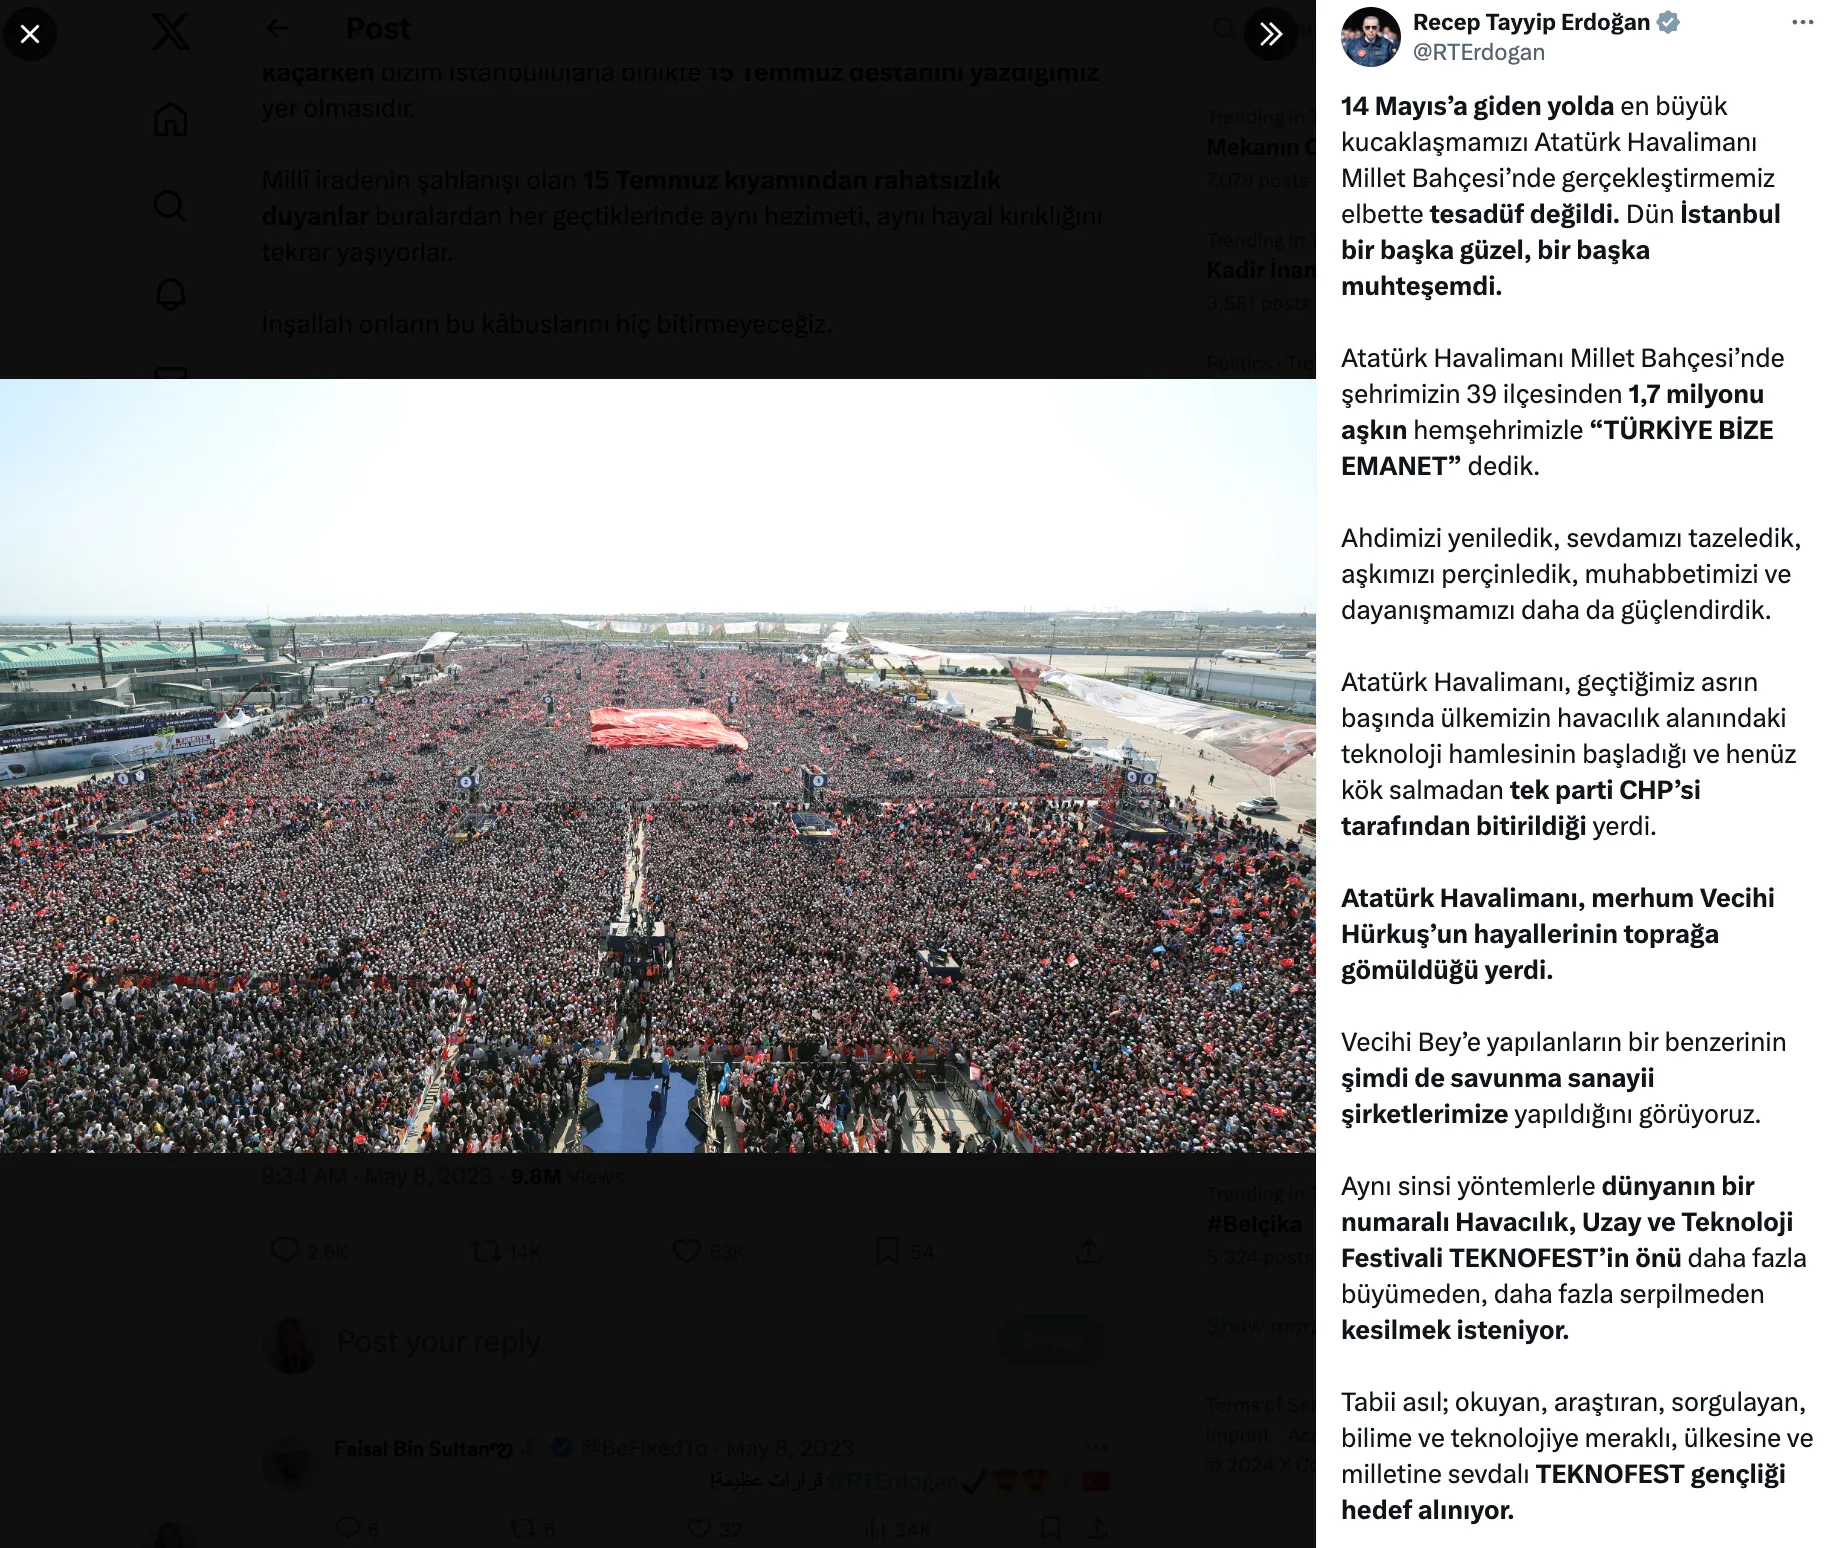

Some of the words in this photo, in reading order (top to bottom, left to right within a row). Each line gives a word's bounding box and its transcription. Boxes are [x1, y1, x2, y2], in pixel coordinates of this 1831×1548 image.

[347, 17, 411, 40] Post
[1415, 14, 1480, 34] Recep
[1486, 13, 1555, 35] Tayyip
[1563, 13, 1649, 35] Erdoğan
[1414, 43, 1544, 64] @RTErdogan
[262, 103, 297, 122] yer
[304, 97, 414, 117] olmasıdır.
[1342, 97, 1369, 115] 14
[1377, 95, 1467, 120] Mayıs’a
[1474, 95, 1540, 120] giden
[1548, 95, 1613, 120] yolda
[1621, 101, 1648, 115] en
[1657, 95, 1727, 120] büyük
[1343, 131, 1527, 156] kucaklaşmamızı
[1535, 131, 1621, 151] Atatürk
[1629, 131, 1755, 151] Havalimanı
[264, 170, 310, 189] Millî
[317, 169, 409, 190] iradenin
[418, 169, 518, 194] şahlanışı
[527, 169, 576, 190] olan
[584, 171, 609, 189] 15
[616, 171, 718, 189] Temmuz
[726, 169, 867, 194] kıyamından
[875, 169, 1001, 190] rahatsızlık
[1343, 167, 1405, 187] Millet
[1414, 167, 1555, 192] Bahçesi’nde
[1562, 167, 1774, 192] gerçekleştirmemiz
[263, 204, 370, 230] duyanlar
[377, 206, 501, 227] buralardan
[510, 206, 547, 225] her
[553, 205, 704, 230] geçtiklerinde
[711, 211, 756, 230] aynı
[766, 205, 870, 228] hezimeti,
[878, 211, 923, 230] aynı
[933, 206, 992, 230] hayal
[1001, 205, 1101, 230] kırıklığını
[1342, 203, 1423, 223] elbette
[1430, 203, 1524, 223] tesadüf
[1531, 203, 1619, 228] değildi.
[1628, 204, 1673, 223] Dün
[1682, 200, 1779, 223] İstanbul
[262, 242, 331, 263] tekrar
[337, 242, 452, 266] yaşıyorlar.
[1343, 239, 1374, 259] bir
[1382, 239, 1453, 264] başka
[1460, 239, 1530, 264] güzel,
[1539, 239, 1570, 259] bir
[1578, 239, 1649, 264] başka
[1343, 275, 1501, 300] muhteşemdi.
[264, 310, 352, 338] İnşallah
[360, 314, 438, 333] onların
[447, 313, 474, 334] bu
[483, 313, 608, 334] kâbuslarını
[617, 314, 650, 338] hiç
[658, 314, 832, 338] bitirmeyeceğiz.
[1341, 347, 1427, 367] Atatürk
[1436, 347, 1562, 367] Havalimanı
[1572, 347, 1634, 367] Millet
[1643, 347, 1784, 372] Bahçesi’nde
[1342, 383, 1459, 408] şehrimizin
[1468, 384, 1496, 403] 39
[1504, 383, 1621, 408] ilçesinden
[1629, 385, 1660, 407] 1,7
[1668, 383, 1763, 408] milyonu
[1342, 419, 1406, 444] aşkın
[1415, 419, 1582, 444] hemşehrimizle
[1591, 416, 1712, 439] “TÜRKİYE
[1720, 416, 1773, 439] BİZE
[1343, 455, 1460, 475] EMANET”
[1469, 455, 1539, 475] dedik.
[1341, 527, 1441, 547] Ahdimizi
[1448, 527, 1559, 552] yeniledik,
[1568, 527, 1680, 547] sevdamızı
[1689, 527, 1800, 551] tazeledik,
[1342, 563, 1433, 588] aşkımızı
[1443, 563, 1577, 588] perçinledik,
[1586, 563, 1757, 583] muhabbetimizi
[1765, 569, 1790, 583] ve
[1342, 599, 1513, 624] dayanışmamızı
[1522, 599, 1579, 619] daha
[1587, 599, 1614, 619] da
[1621, 599, 1770, 624] güçlendirdik.
[1341, 671, 1427, 691] Atatürk
[1436, 671, 1570, 695] Havalimanı,
[1578, 671, 1694, 696] geçtiğimiz
[1702, 677, 1757, 691] asrın
[1343, 707, 1434, 732] başında
[1442, 707, 1550, 727] ülkemizin
[1559, 707, 1659, 727] havacılık
[1667, 707, 1785, 727] alanındaki
[1341, 743, 1441, 768] teknoloji
[1450, 743, 1575, 763] hamlesinin
[1584, 743, 1685, 768] başladığı
[1693, 749, 1719, 763] ve
[1727, 743, 1796, 763] henüz
[1343, 779, 1383, 799] kök
[1390, 779, 1502, 799] salmadan
[1510, 779, 1549, 799] tek
[1557, 779, 1612, 804] parti
[1620, 779, 1700, 799] CHP’si
[1341, 815, 1469, 835] tarafından
[1478, 815, 1585, 840] bitirildiği
[1593, 815, 1655, 840] yerdi.
[1341, 1177, 1390, 1200] Aynı
[1399, 1176, 1450, 1195] sinsi
[1458, 1175, 1595, 1200] yöntemlerle
[1602, 1175, 1714, 1200] dünyanın
[1723, 1175, 1755, 1195] bir
[1207, 1214, 1301, 1236] #Belçika
[1343, 1211, 1448, 1231] numaralı
[1457, 1211, 1575, 1235] Havacılık,
[1584, 1213, 1641, 1236] Uzay
[1648, 1217, 1675, 1231] ve
[1682, 1211, 1792, 1236] Teknoloji
[1343, 1247, 1442, 1267] Festivali
[1449, 1247, 1628, 1267] TEKNOFEST’in
[1636, 1248, 1680, 1267] önü
[1689, 1247, 1745, 1267] daha
[1752, 1247, 1806, 1267] fazla
[1343, 1283, 1486, 1308] büyümeden,
[1495, 1283, 1551, 1303] daha
[1559, 1283, 1612, 1303] fazla
[1621, 1283, 1763, 1308] serpilmeden
[339, 1330, 398, 1352] Post
[407, 1336, 466, 1358] your
[476, 1329, 540, 1358] reply
[1343, 1319, 1451, 1339] kesilmek
[1458, 1319, 1568, 1344] isteniyor.
